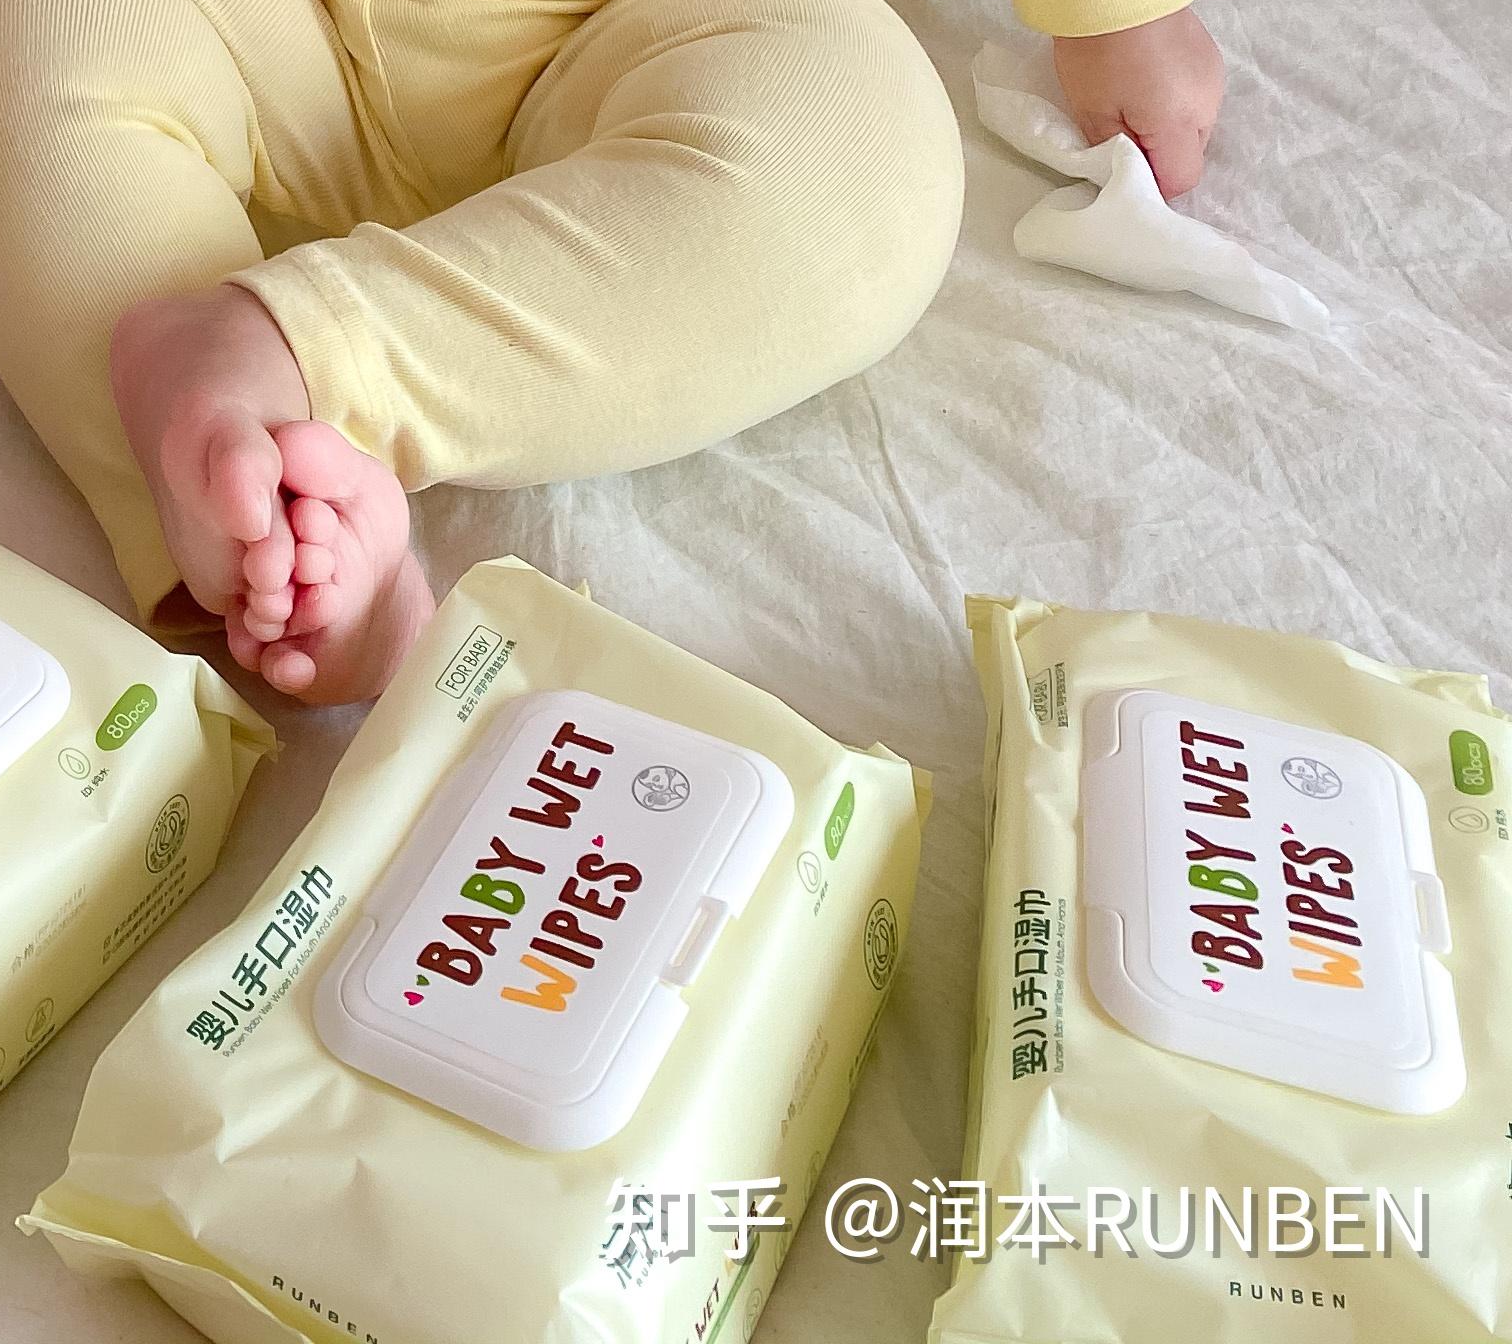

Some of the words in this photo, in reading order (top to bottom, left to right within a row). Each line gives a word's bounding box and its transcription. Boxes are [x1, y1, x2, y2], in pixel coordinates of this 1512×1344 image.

[106, 698, 150, 739] 80pcs
[445, 664, 473, 692] FOR
[463, 635, 491, 667] BABY
[1180, 720, 1252, 819] WET
[416, 836, 546, 986] BABY
[508, 721, 615, 829] WET
[1185, 828, 1264, 970] BABY
[186, 864, 333, 1051] 婴儿手口湿巾
[289, 965, 301, 980] For
[298, 940, 319, 967] Mouth
[316, 920, 331, 941] And
[500, 853, 642, 1011] WIPES
[1280, 840, 1364, 989] WIPES
[1012, 889, 1051, 1080] 婴儿手口湿巾
[271, 1274, 379, 1344] RUNBEN
[1228, 1280, 1348, 1311] RUNBEN
